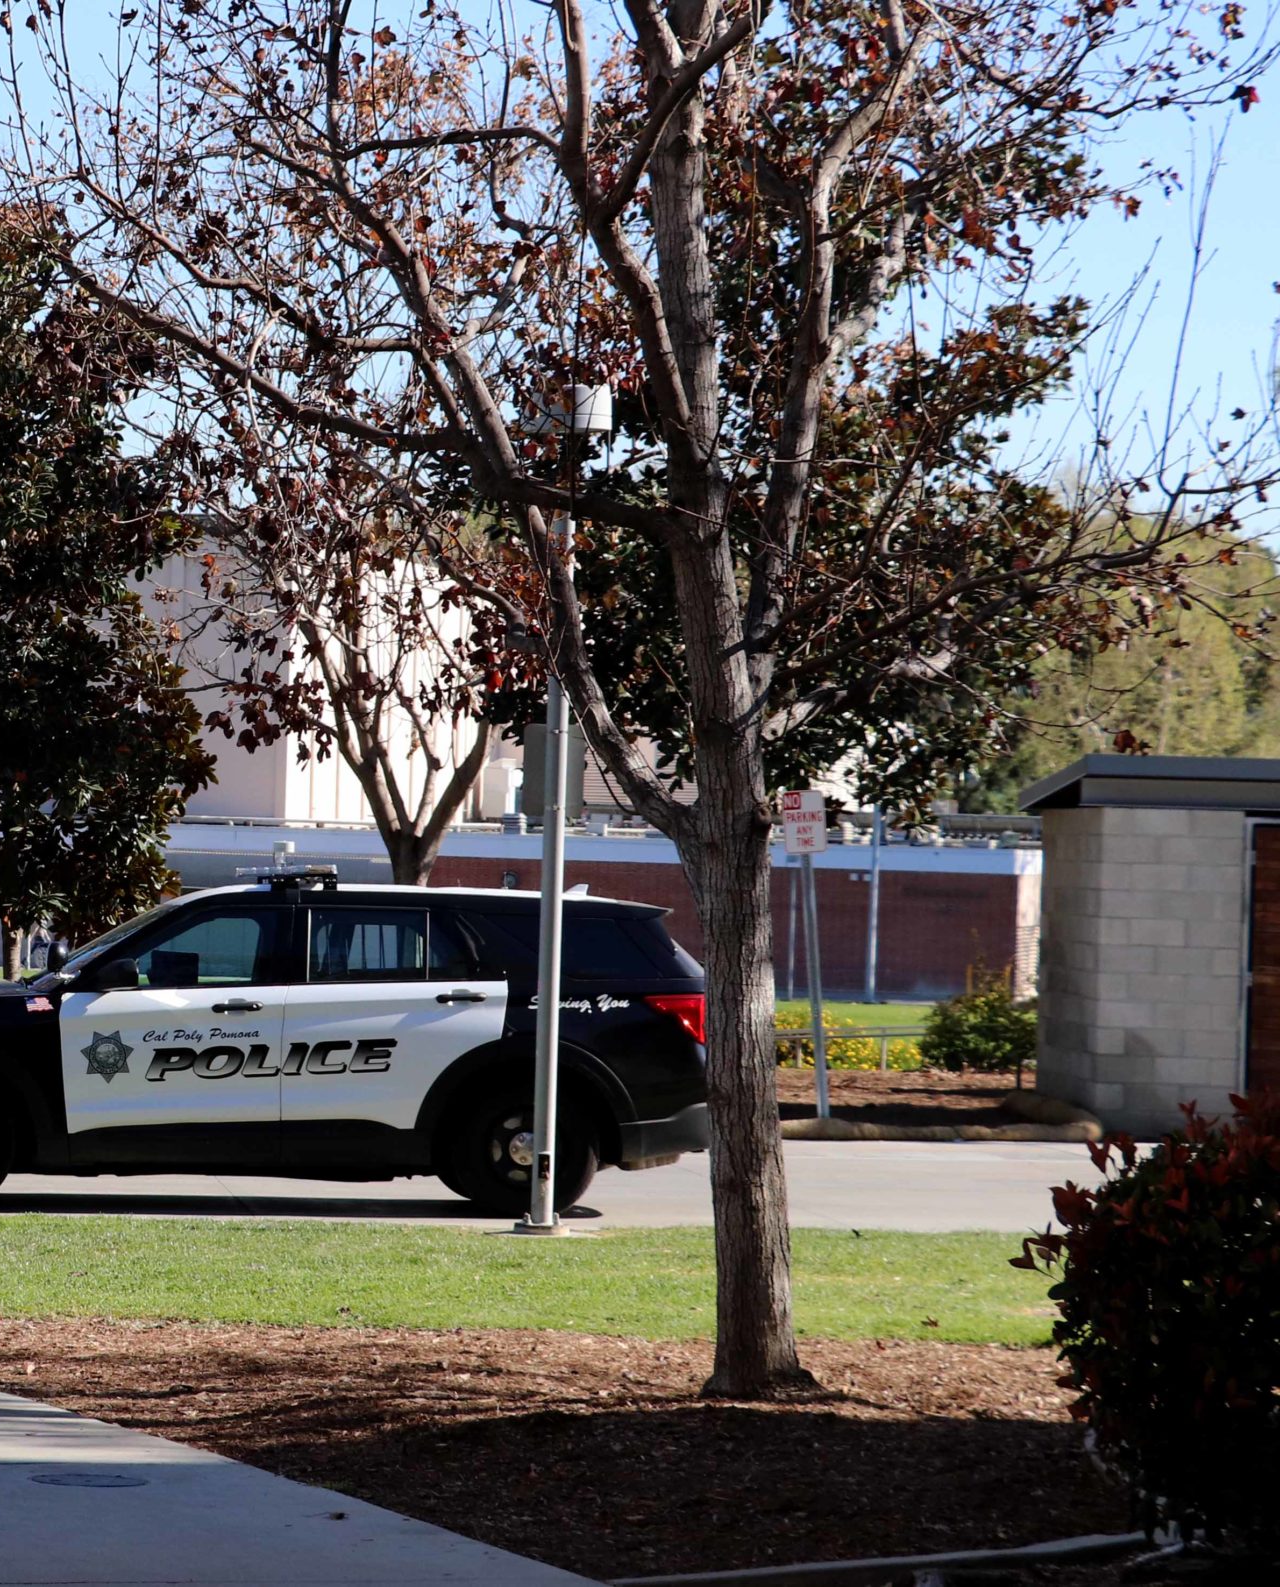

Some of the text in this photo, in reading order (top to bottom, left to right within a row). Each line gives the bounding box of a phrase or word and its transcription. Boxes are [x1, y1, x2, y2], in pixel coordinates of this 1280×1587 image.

[784, 795, 799, 808] NO
[786, 811, 823, 823] PARKING
[796, 826, 813, 834] ANY
[796, 837, 815, 847] TIME
[527, 994, 630, 1013] Sving You
[142, 1027, 260, 1043] Cal Poly Pomona
[145, 1038, 398, 1081] POLICE
